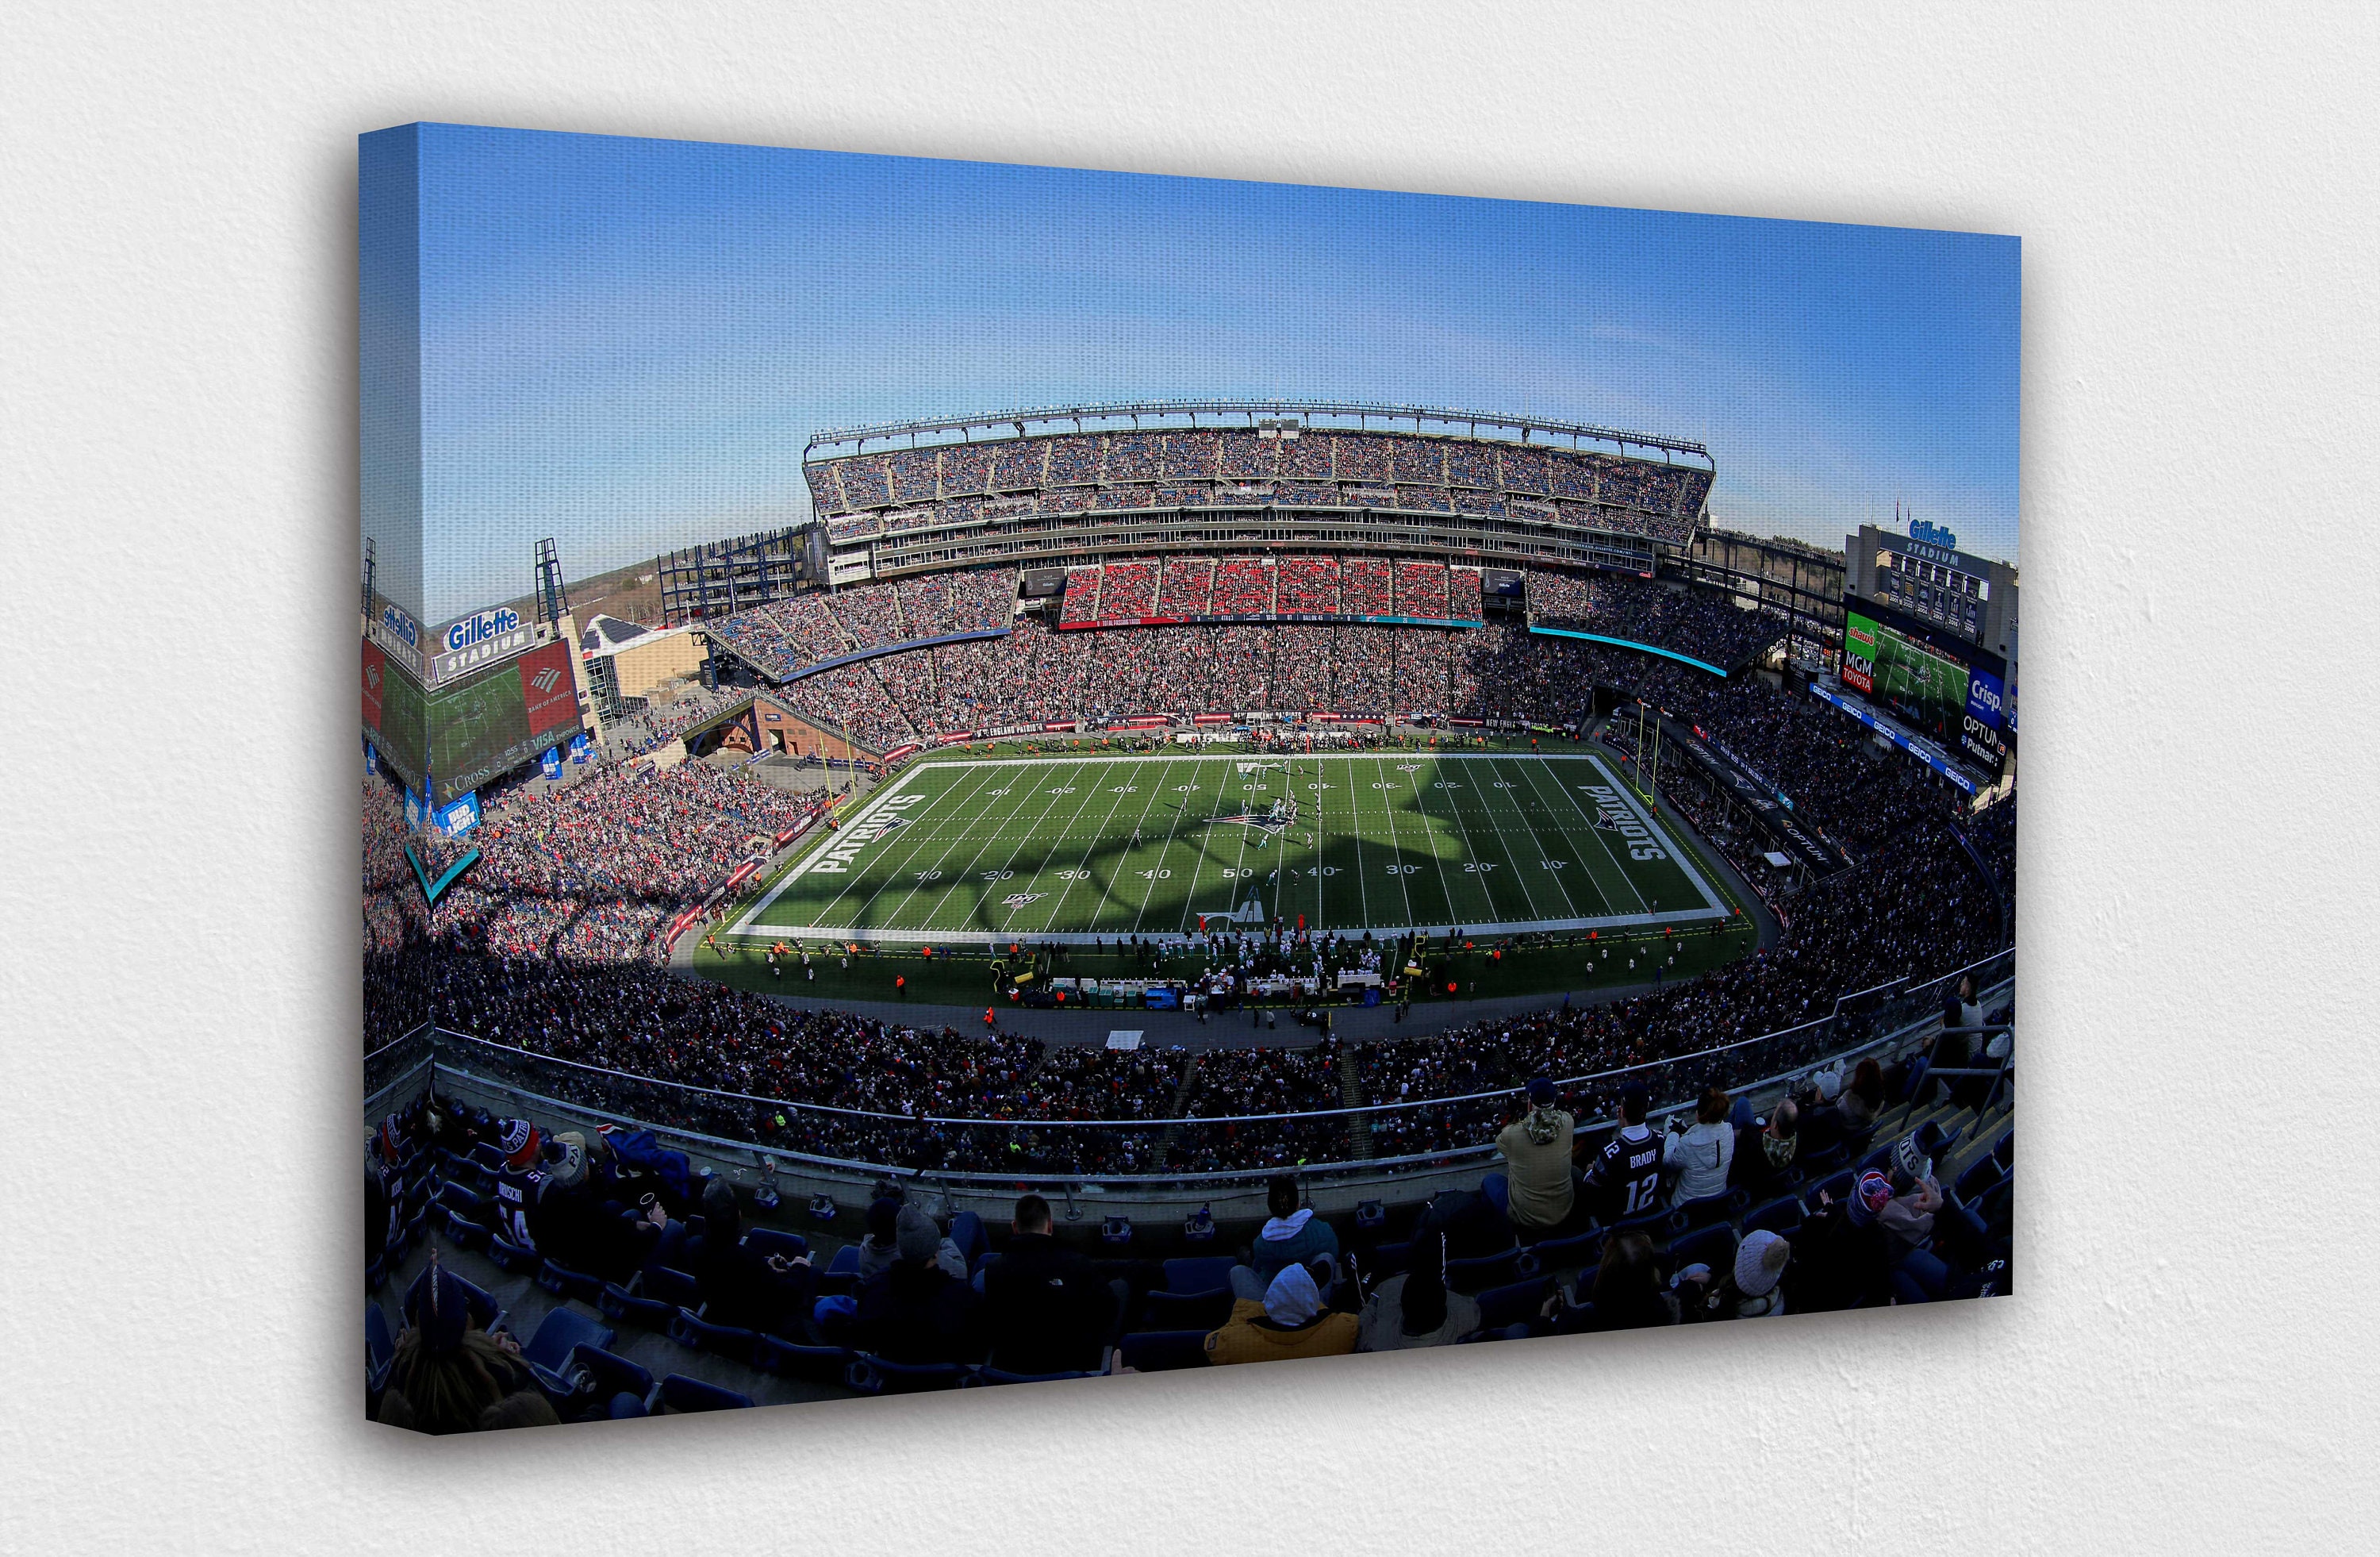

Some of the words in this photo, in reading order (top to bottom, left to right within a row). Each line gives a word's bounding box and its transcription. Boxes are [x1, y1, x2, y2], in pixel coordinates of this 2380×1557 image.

[1910, 519, 1956, 550] Gillette
[1907, 543, 1959, 566] STADIUM
[449, 609, 518, 650] Gillette
[447, 631, 525, 671] STADIUM
[1846, 651, 1872, 677] MGM
[1844, 667, 1871, 690] TOYOTA
[528, 703, 542, 713] BANK
[550, 690, 572, 704] AMERICA
[1813, 686, 1832, 701] GEICO
[1842, 702, 1862, 719] GEICO
[556, 725, 580, 740] EMPOWER
[990, 725, 1015, 736] ENGLAND
[1016, 723, 1043, 733] PATRIOTS
[1486, 718, 1499, 727] NEW
[1874, 721, 1895, 740] GEICO
[505, 745, 518, 756] 10:55
[530, 731, 555, 751] VISA
[1690, 744, 1719, 764] OPTUM
[1908, 742, 1931, 763] GEICO
[1945, 767, 1970, 790] GEICO
[447, 803, 470, 823] BUD
[447, 810, 477, 836] LIGHT
[809, 794, 927, 873] PATRIOTS
[1577, 786, 1667, 861] PATRIOTS
[1787, 828, 1828, 861] OPTUM
[985, 870, 1015, 880] 20
[1060, 870, 1091, 880] 30
[1142, 869, 1172, 879] 40
[1222, 868, 1253, 878] 50
[1307, 866, 1335, 877] 40
[1386, 864, 1415, 875] 30
[1464, 862, 1491, 872] 20
[1540, 859, 1562, 871] 10
[917, 871, 942, 880] 10
[1603, 1140, 1620, 1159] 12
[1630, 1148, 1656, 1169] BRADY
[1623, 1173, 1658, 1216] 12
